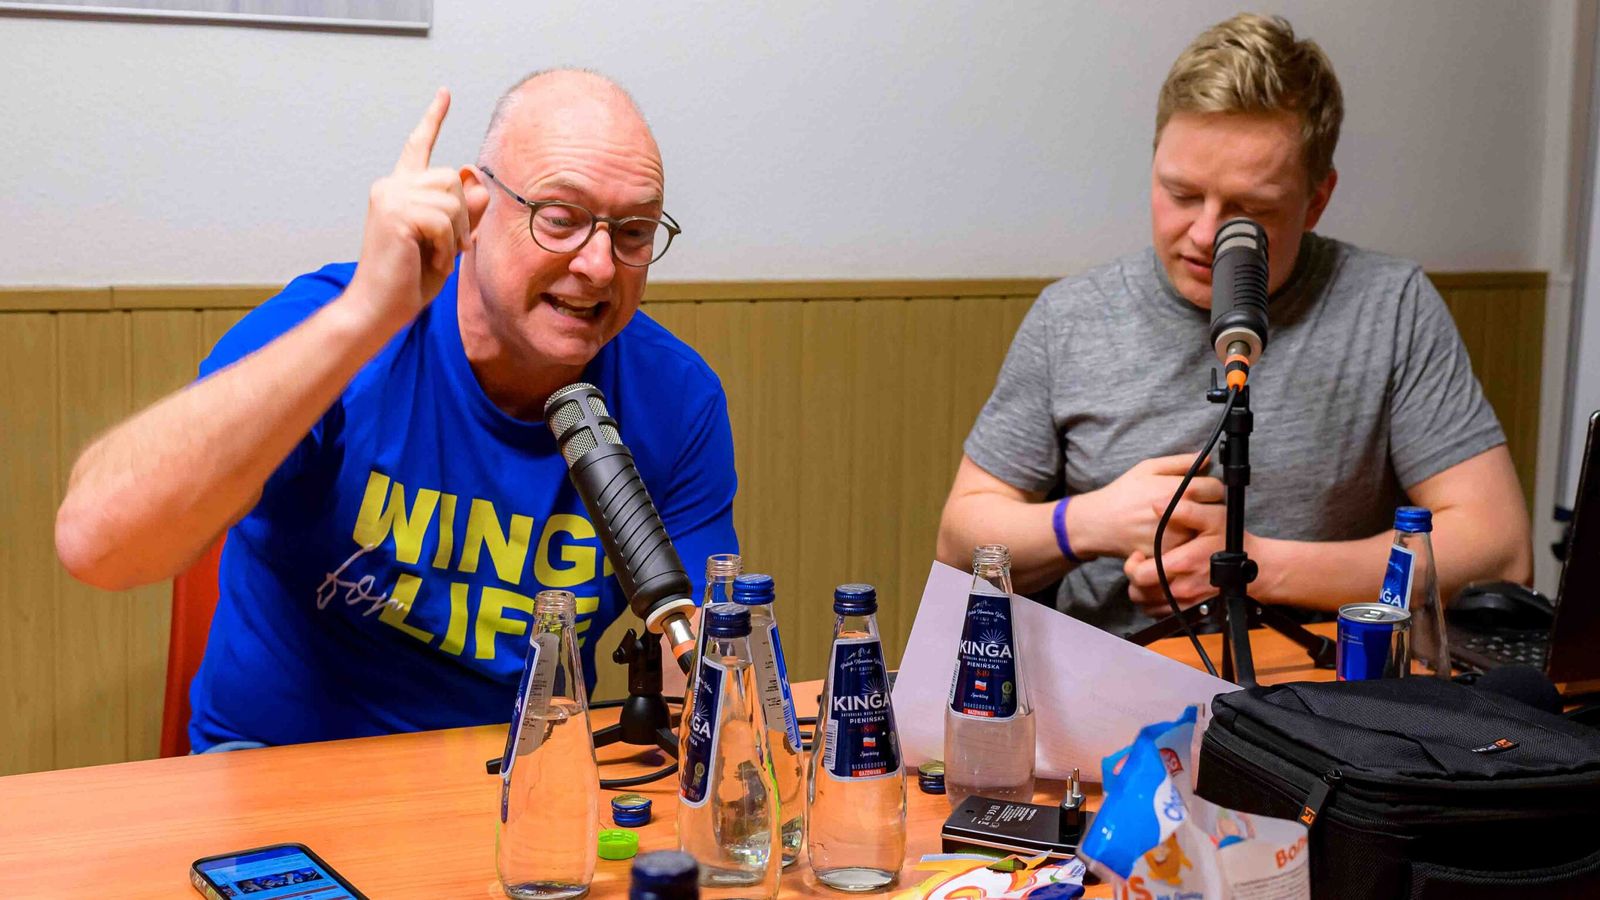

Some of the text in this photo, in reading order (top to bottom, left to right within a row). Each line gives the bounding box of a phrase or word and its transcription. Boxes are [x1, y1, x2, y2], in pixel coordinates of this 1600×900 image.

[353, 471, 617, 588] WING
[959, 639, 1013, 659] KINGA
[833, 691, 891, 712] KINGA
